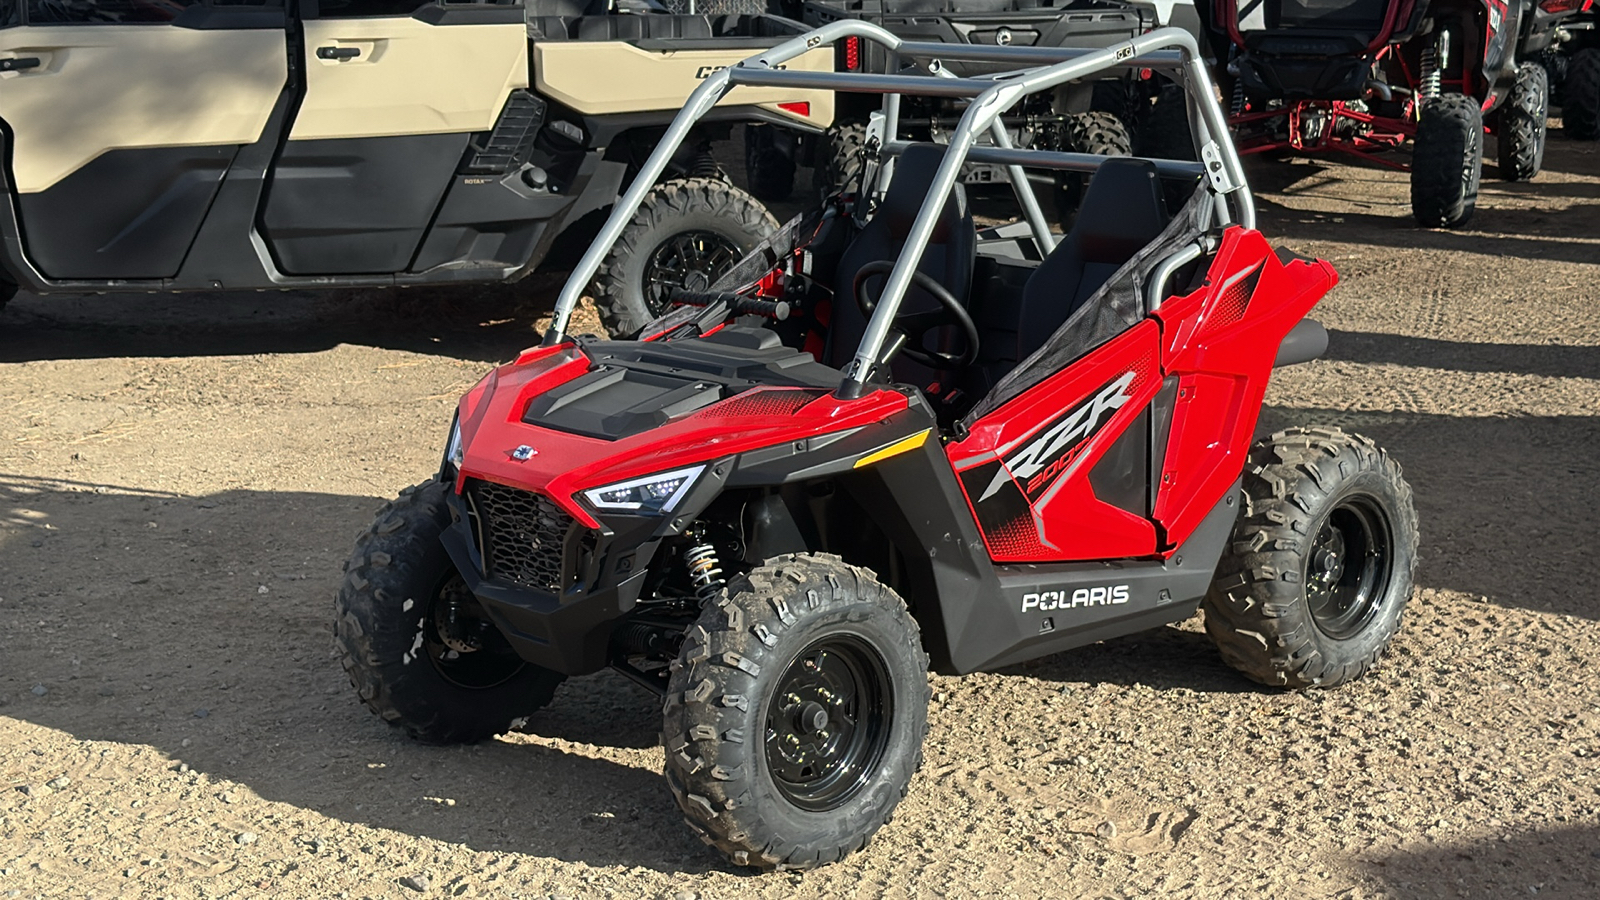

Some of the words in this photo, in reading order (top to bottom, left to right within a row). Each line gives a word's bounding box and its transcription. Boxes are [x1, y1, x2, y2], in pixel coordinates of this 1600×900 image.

[978, 371, 1137, 503] RZR
[1027, 447, 1075, 494] 200
[1021, 585, 1129, 613] POLARIS
